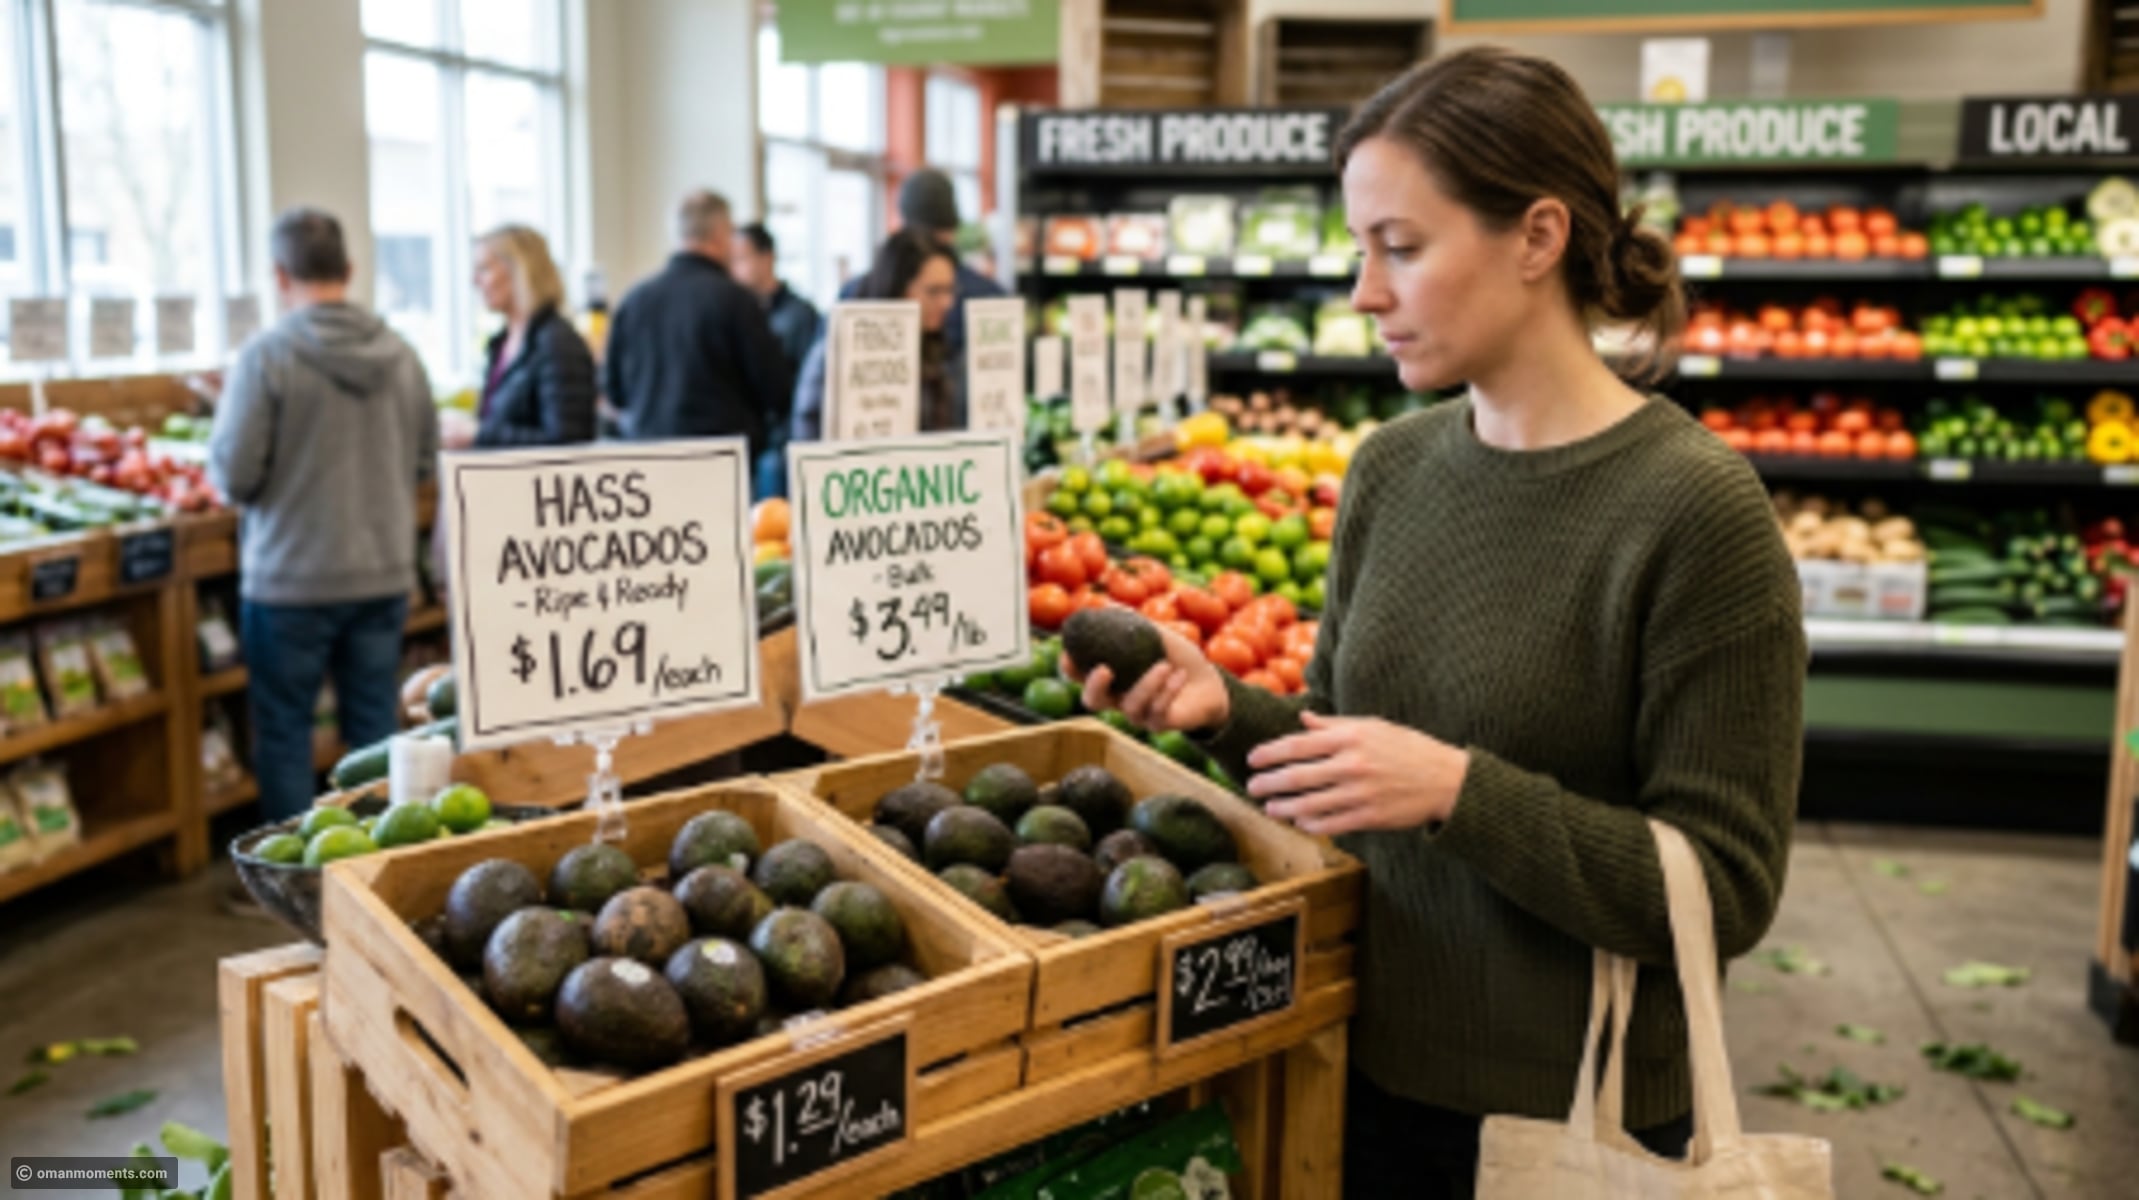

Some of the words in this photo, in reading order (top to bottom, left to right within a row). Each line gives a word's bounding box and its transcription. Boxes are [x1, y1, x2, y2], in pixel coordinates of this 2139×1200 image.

[1038, 115, 1151, 162] FRESH
[1159, 112, 1329, 162] PRODUCE
[1596, 109, 1664, 157] SH
[1675, 106, 1867, 157] PRODUCE
[1988, 104, 2129, 154] LOCAL
[533, 470, 652, 527] HASS
[821, 459, 982, 519] ORGANIC
[497, 520, 708, 586] AVOCADOS
[824, 512, 984, 566] AVOCADOS
[534, 586, 591, 622] Ripe
[615, 572, 689, 613] Ready
